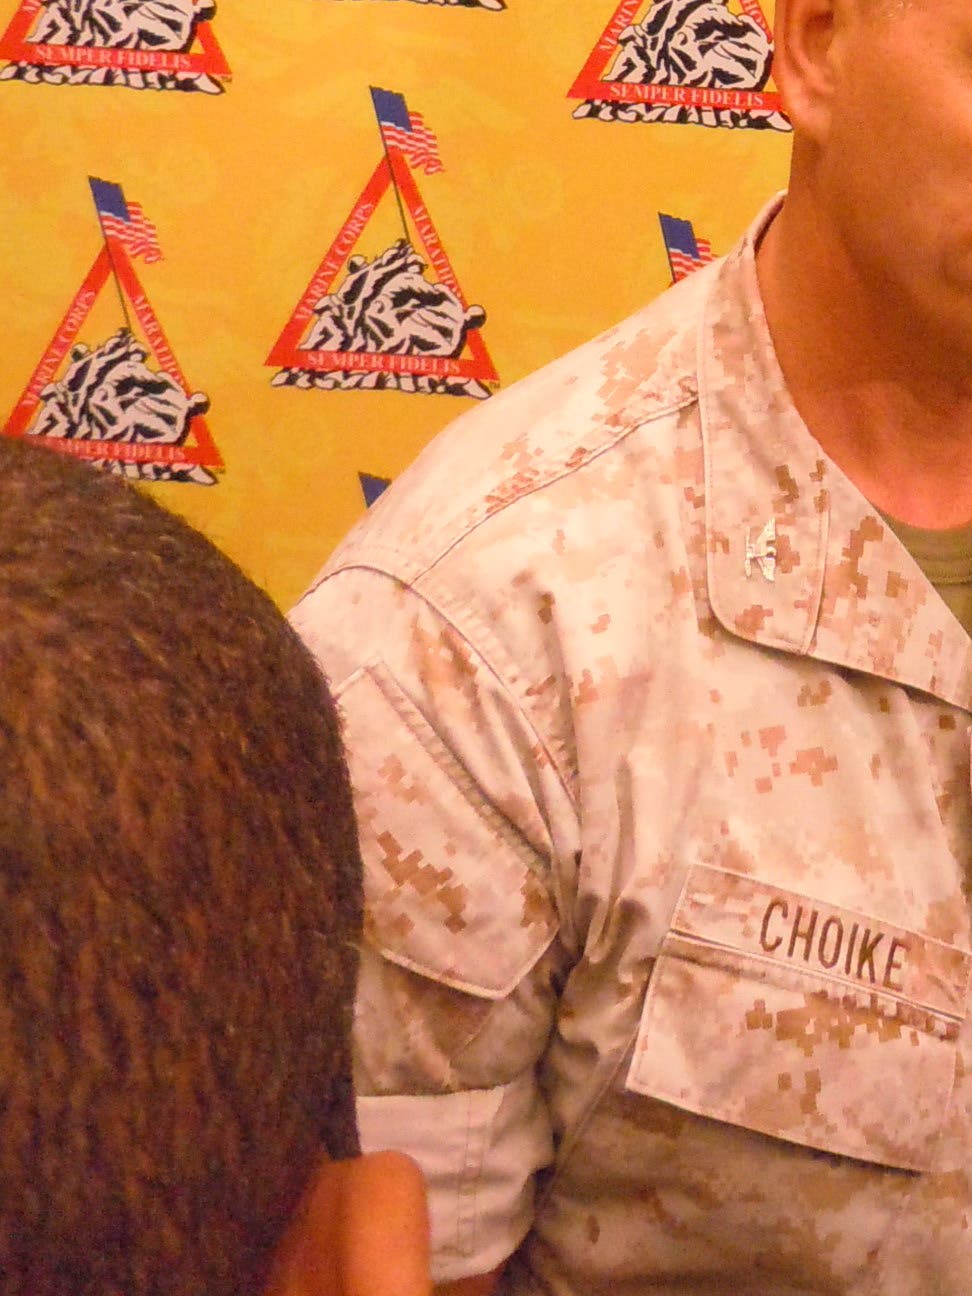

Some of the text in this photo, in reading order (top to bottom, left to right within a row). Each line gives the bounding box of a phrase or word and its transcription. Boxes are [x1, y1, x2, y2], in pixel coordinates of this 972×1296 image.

[609, 84, 764, 106] SEMPER FIDELIS
[759, 897, 912, 991] CHOIKE
